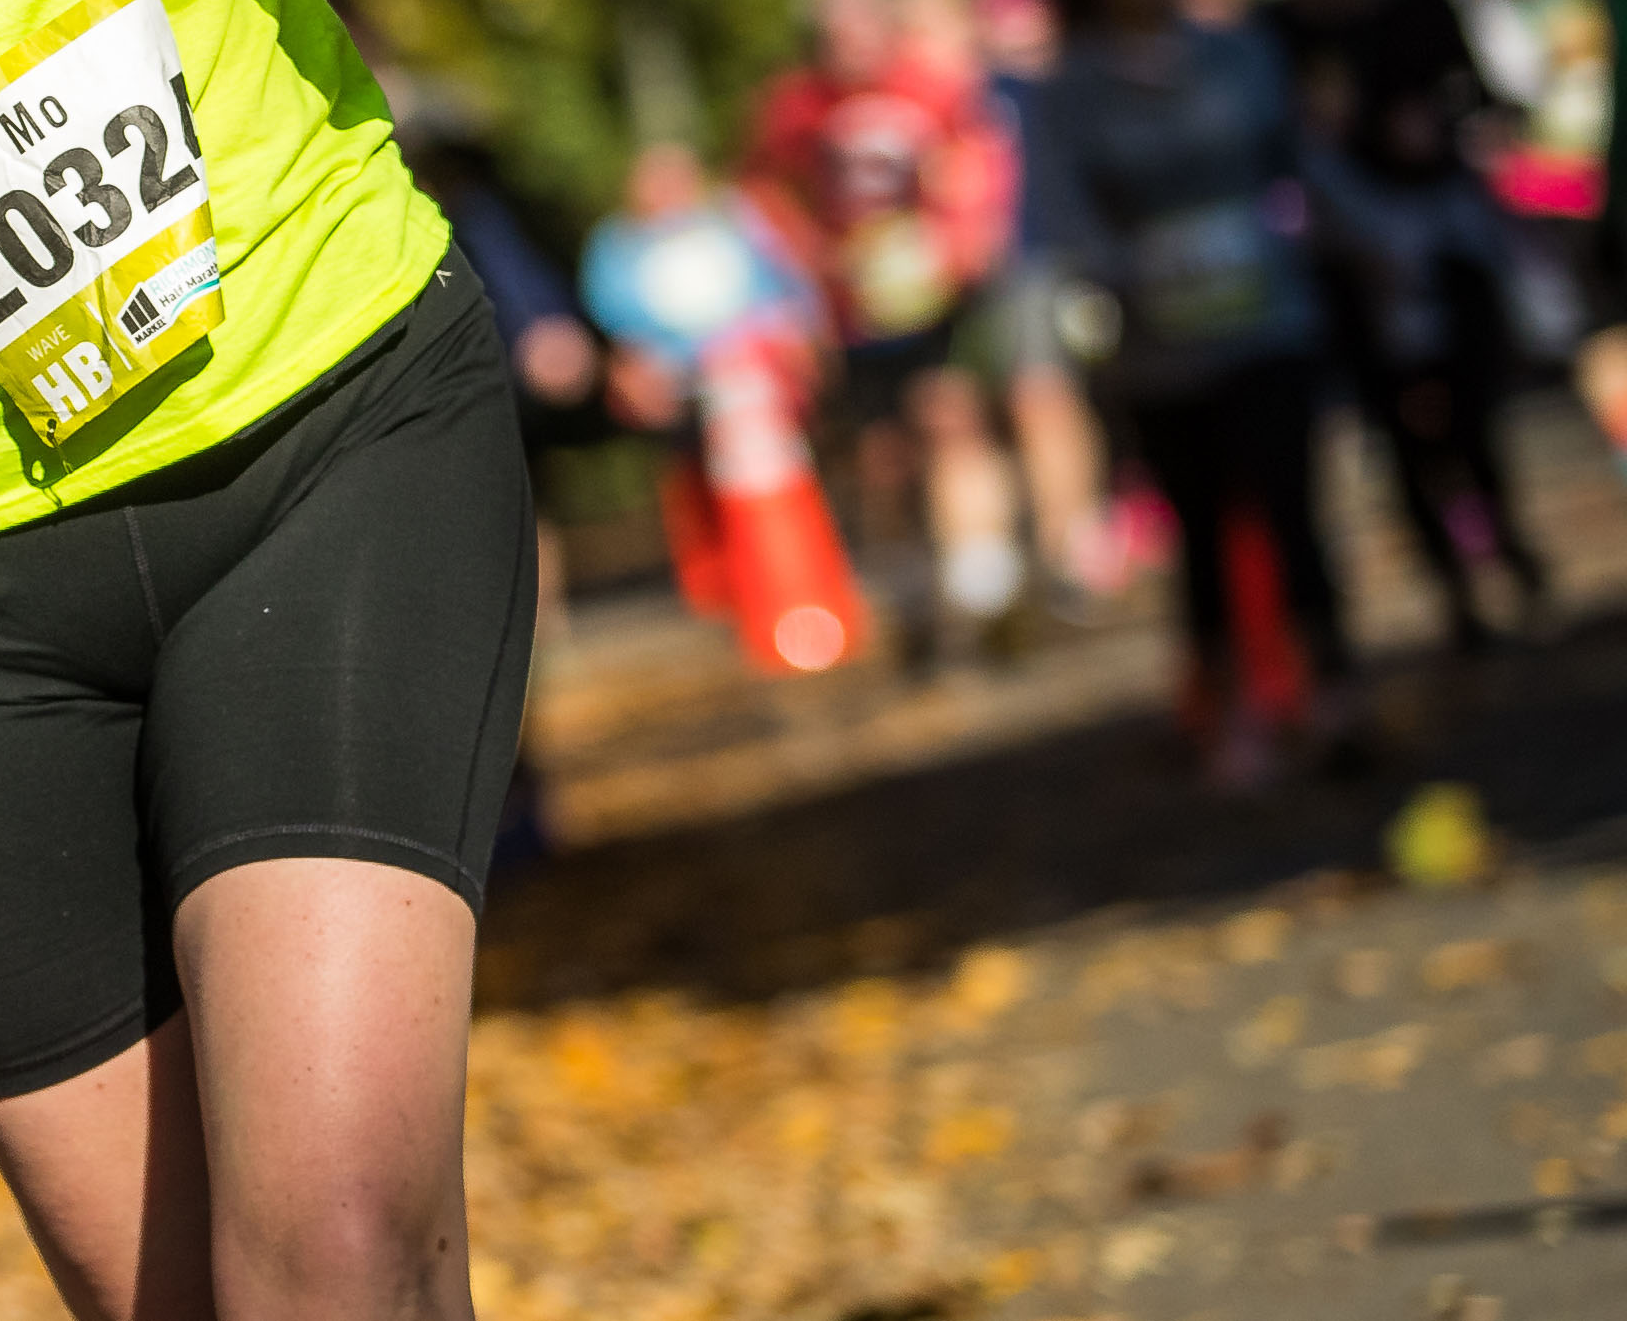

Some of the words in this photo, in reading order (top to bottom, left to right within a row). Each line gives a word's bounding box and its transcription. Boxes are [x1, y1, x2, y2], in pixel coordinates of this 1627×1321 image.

[148, 240, 216, 296] RICHMON
[159, 284, 184, 308] Half
[185, 263, 219, 289] Marat
[26, 324, 71, 361] WAVE
[134, 319, 167, 344] MARKEL
[31, 341, 114, 424] HB
